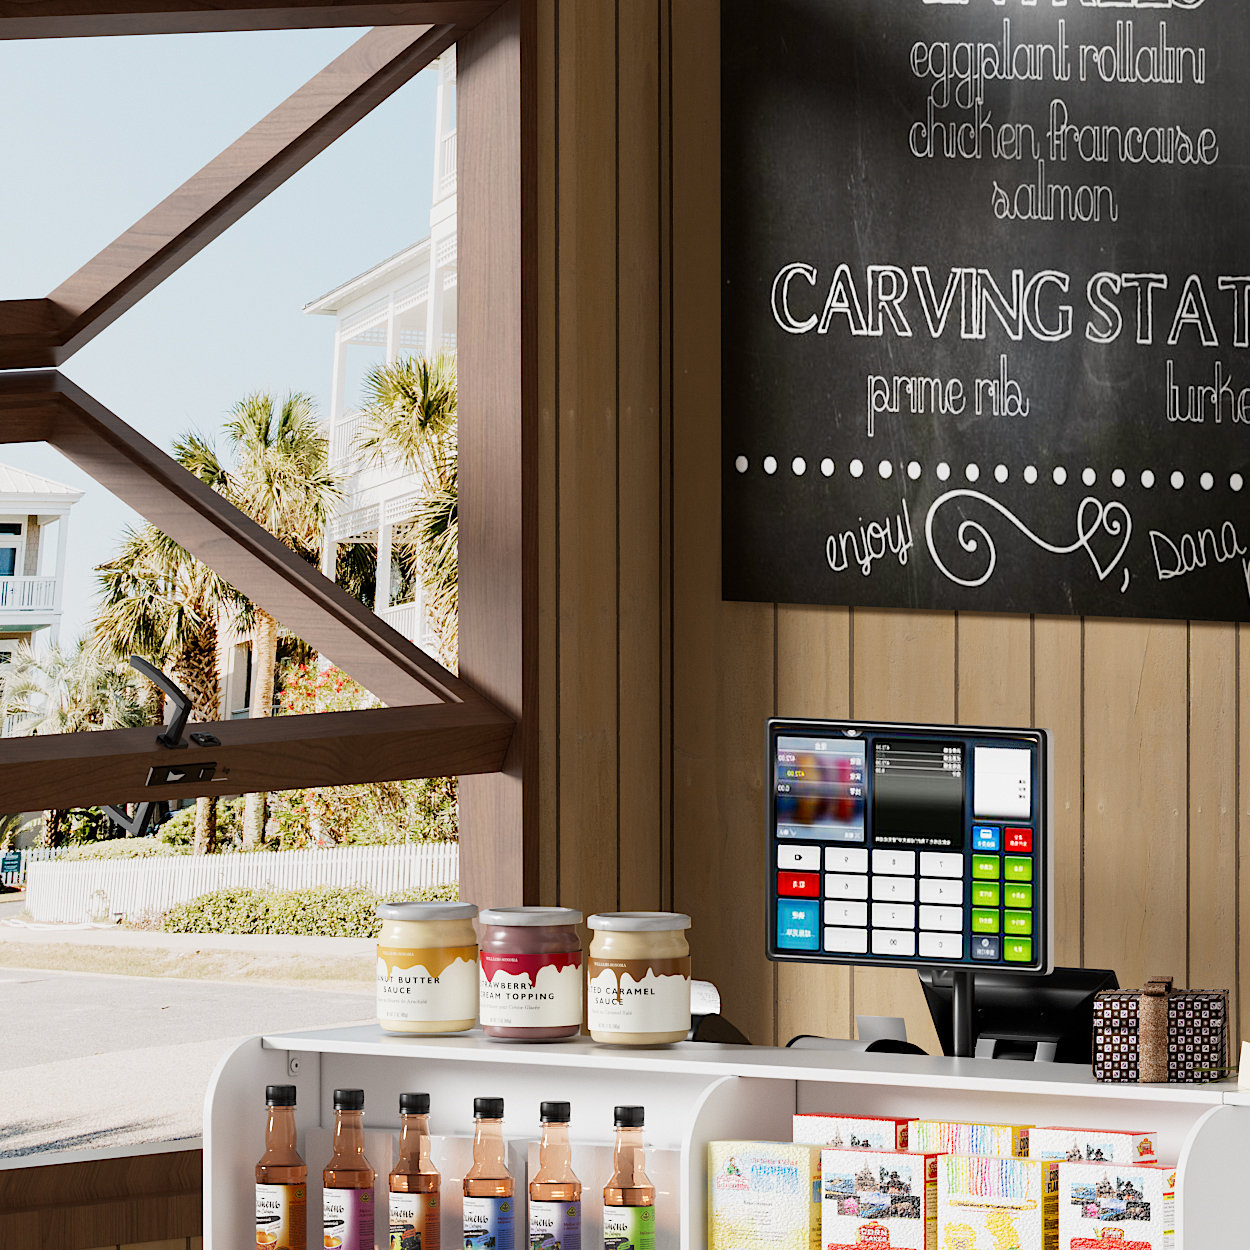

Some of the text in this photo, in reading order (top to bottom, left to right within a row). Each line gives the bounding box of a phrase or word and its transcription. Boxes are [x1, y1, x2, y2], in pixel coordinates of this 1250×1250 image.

[910, 18, 1205, 109] eggplant rollatini
[908, 96, 1220, 167] chicken francaise
[991, 159, 1119, 224] salmon
[770, 262, 1075, 342] CARVING
[866, 354, 1031, 438] prime rib
[826, 498, 914, 577] enjoy!
[1148, 520, 1247, 581] Dana
[384, 986, 411, 994] SAUCE
[595, 998, 624, 1006] SAUCE
